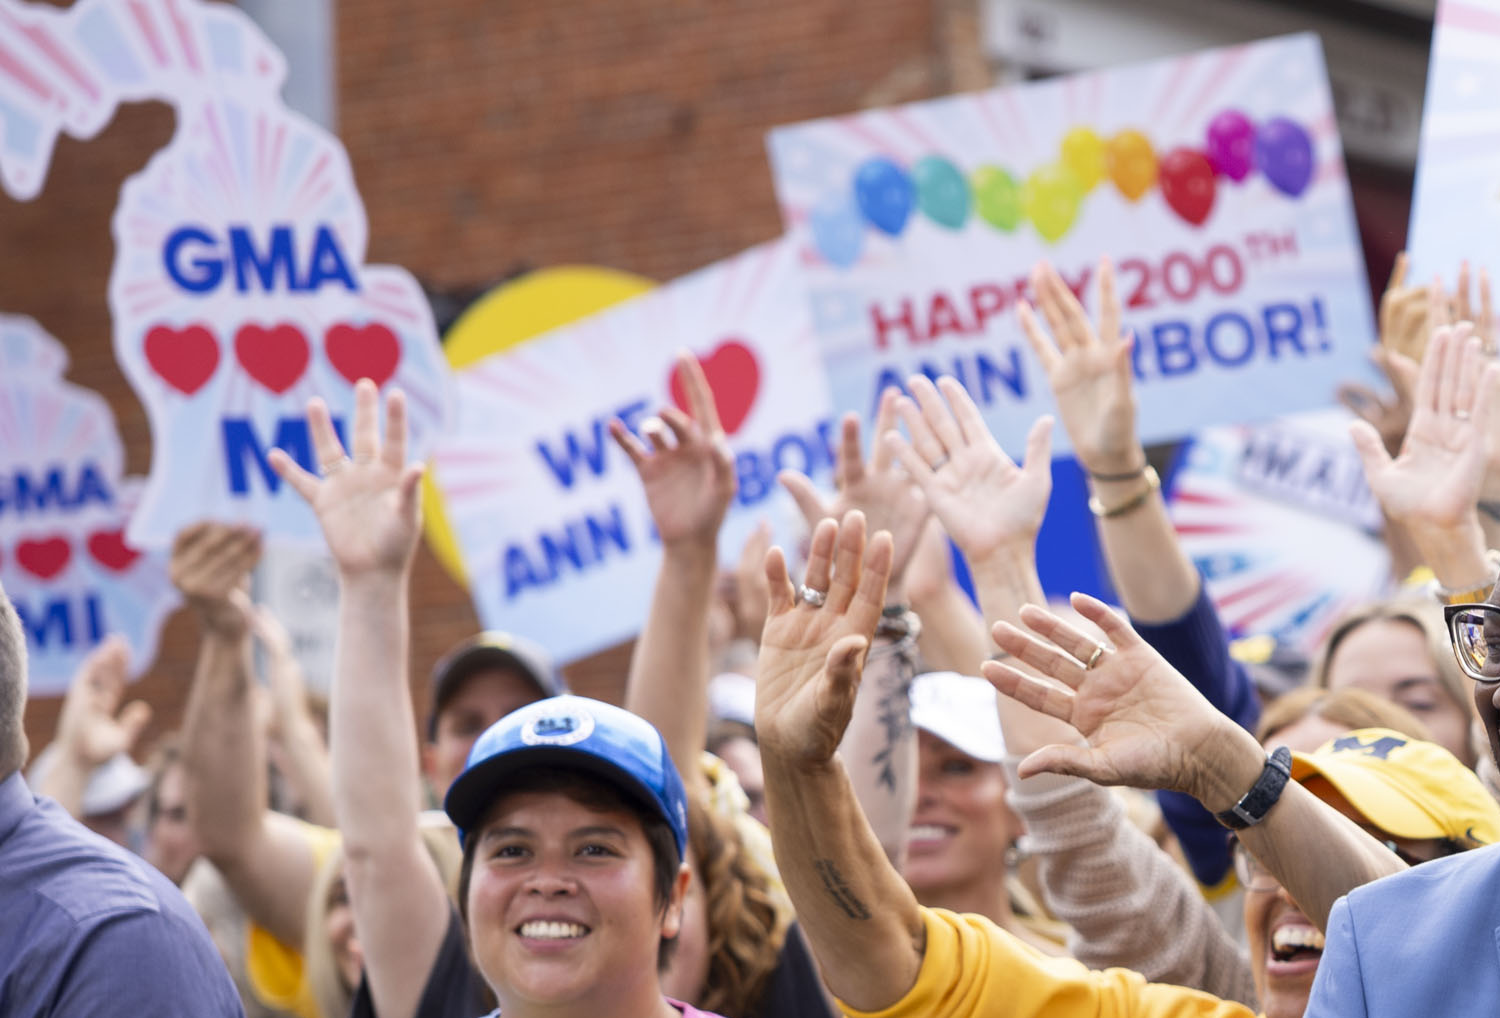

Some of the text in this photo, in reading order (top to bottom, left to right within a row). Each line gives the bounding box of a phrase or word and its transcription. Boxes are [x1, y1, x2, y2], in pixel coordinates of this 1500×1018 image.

[162, 222, 360, 295] GMA
[0, 463, 115, 514] MA
[504, 505, 630, 598] ANN
